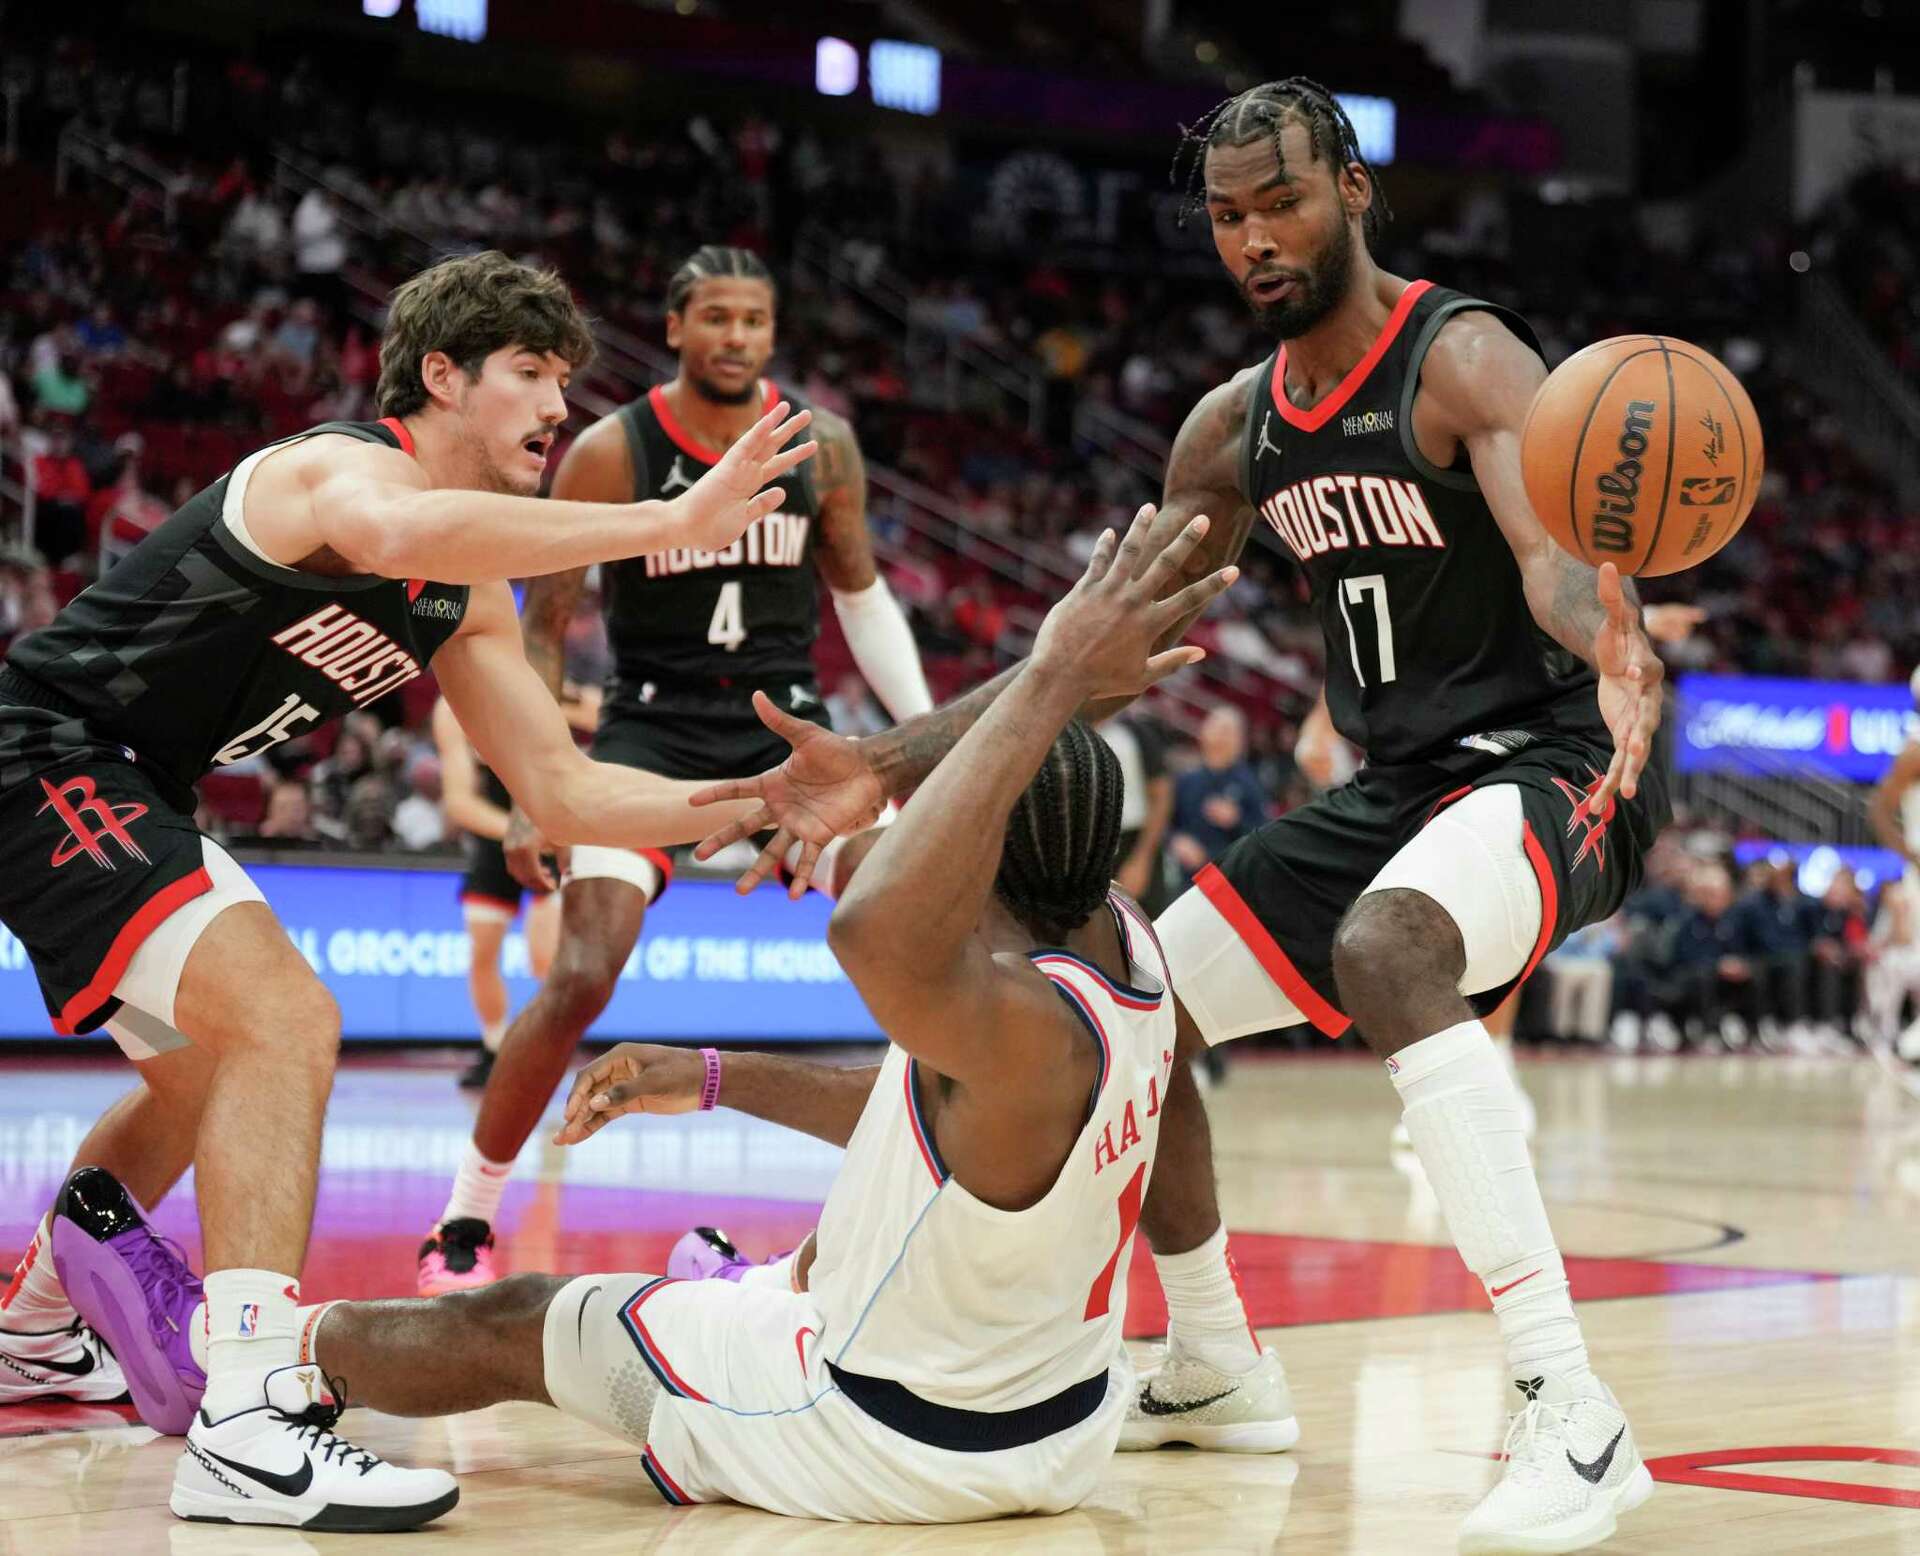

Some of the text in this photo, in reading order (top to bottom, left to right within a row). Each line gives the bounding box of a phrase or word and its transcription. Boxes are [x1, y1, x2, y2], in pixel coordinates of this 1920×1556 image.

[1260, 473, 1447, 562] HOUSTON
[1592, 400, 1656, 553] Wilson
[269, 602, 422, 710] HOUST
[707, 580, 746, 651] 4
[1337, 573, 1397, 689] 17
[209, 692, 321, 766] 15
[327, 928, 475, 978] GROCER
[645, 936, 689, 981] OF
[694, 937, 748, 982] THE
